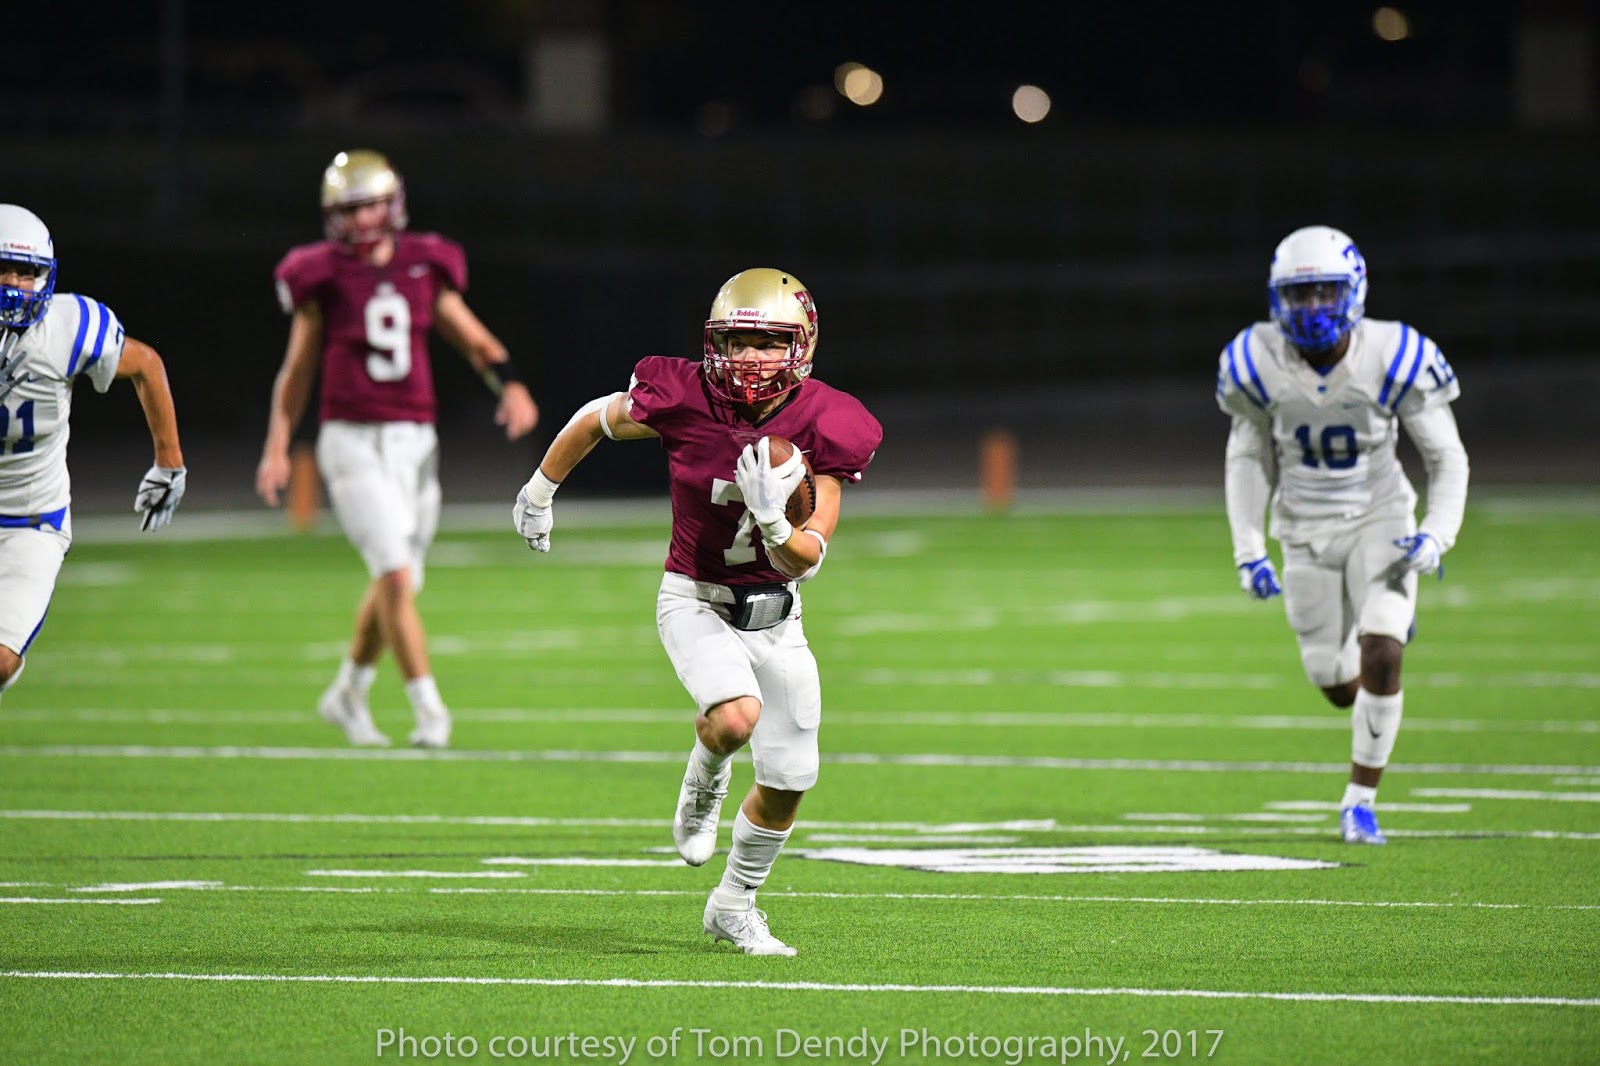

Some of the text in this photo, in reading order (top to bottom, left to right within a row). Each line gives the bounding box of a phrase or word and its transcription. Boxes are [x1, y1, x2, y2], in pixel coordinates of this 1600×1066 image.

[364, 293, 411, 381] 9
[736, 309, 760, 317] Riddell
[1295, 424, 1357, 469] 10
[711, 478, 757, 566] 7
